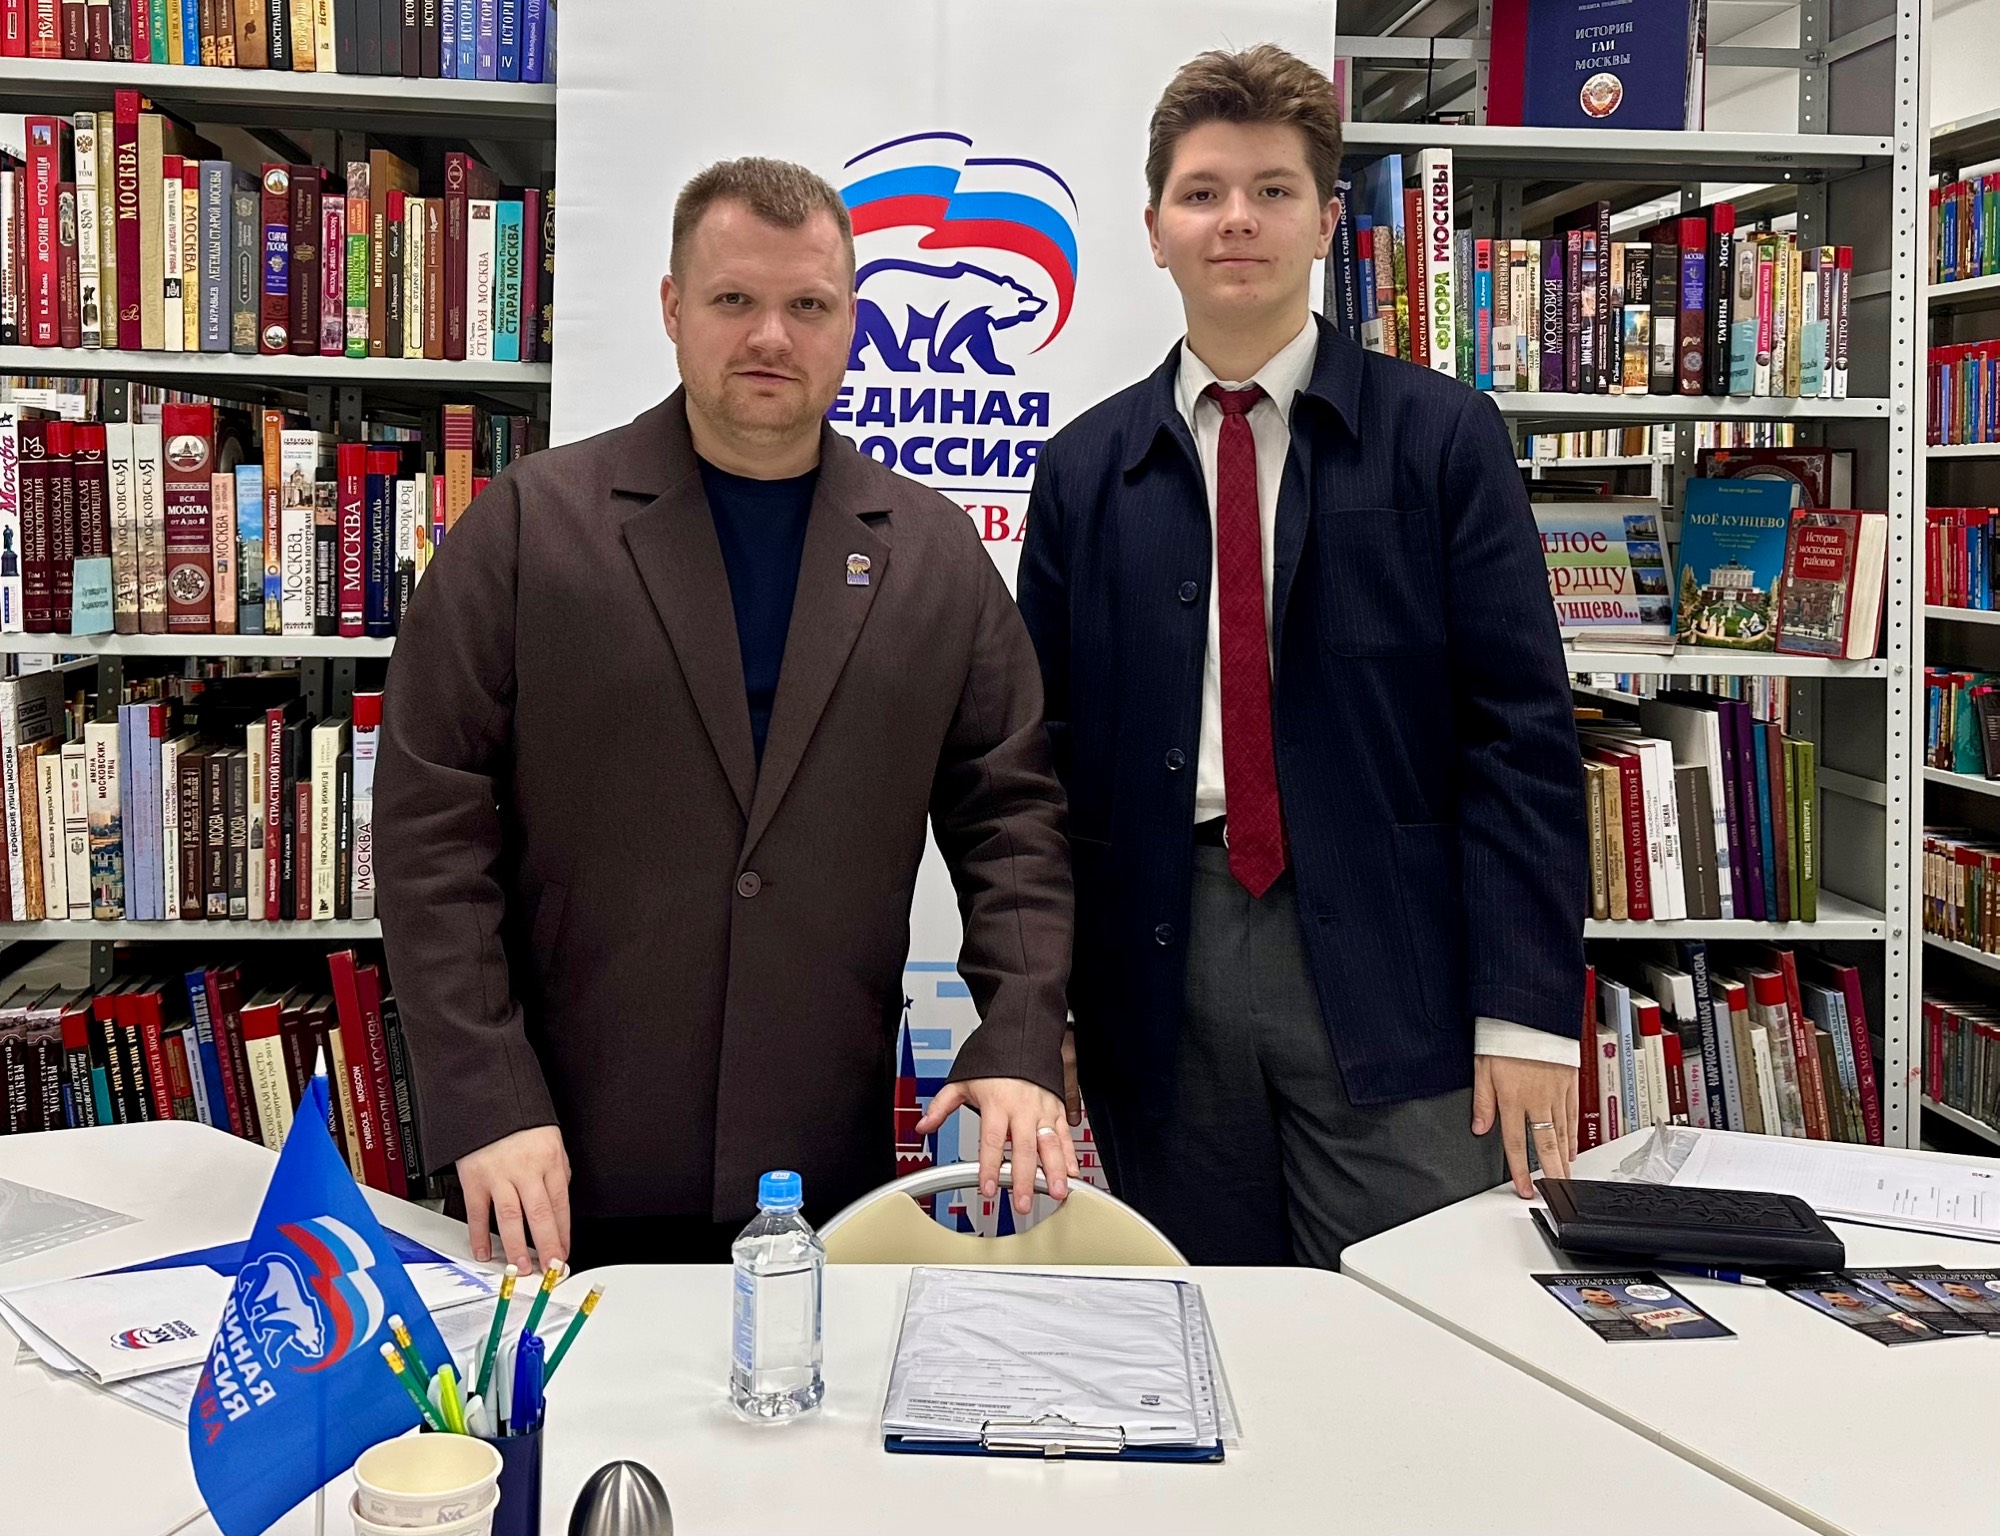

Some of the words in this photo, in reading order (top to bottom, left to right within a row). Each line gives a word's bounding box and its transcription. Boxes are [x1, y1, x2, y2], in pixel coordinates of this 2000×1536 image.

[137, 16, 145, 39] ДУША
[1575, 21, 1634, 40] ИСТОРИЯ
[1592, 40, 1615, 53] ГАИ
[1575, 53, 1631, 71] МОСКВЫ
[37, 157, 50, 205] СТОЛИЦА
[119, 141, 137, 220] МОСКВА
[209, 169, 222, 205] МОСКВЫ
[80, 209, 93, 229] 850
[101, 205, 113, 226] 850
[208, 206, 221, 239] СТАРОЙ
[303, 194, 312, 225] Москвы
[329, 215, 338, 240] Москва
[374, 213, 383, 239] МОСКВЫ
[1339, 192, 1347, 225] РОССИИ
[1415, 197, 1424, 240] МОСКВЫ
[1432, 164, 1450, 262] МОСКВЫ
[37, 217, 49, 262] МОСКВА
[184, 205, 197, 273] МОСКВА
[328, 246, 338, 269] сердце
[506, 223, 519, 279] МОСКВА
[1341, 227, 1349, 256] СУДЬБЕ
[1599, 208, 1609, 277] МИСТИЧЕСКАЯ
[209, 241, 221, 281] ЛЕГЕНДЫ
[476, 251, 489, 304] МОСКВА
[497, 259, 506, 299] Иванович
[1417, 242, 1425, 278] ГОРОДА
[329, 270, 338, 294] России
[412, 272, 420, 300] СТАРОЙ
[1343, 265, 1354, 320] МОСКВА-РЕКА
[1418, 281, 1426, 313] КНИГА
[1499, 257, 1508, 315] ТАИНСТВЕННАЯ
[1599, 280, 1608, 320] МОСКВА
[1822, 271, 1831, 317] московское
[1841, 271, 1849, 317] московское
[209, 286, 219, 324] МУРАВЬЕВ
[497, 301, 505, 334] Михаил
[506, 282, 519, 335] СТАРАЯ
[1434, 271, 1451, 351] ФЛОРА
[1543, 278, 1557, 355] МОСКОВИЯ
[1717, 298, 1728, 344] ТАЙНЫ
[475, 309, 488, 357] СТАРАЯ
[1386, 313, 1395, 347] МОСКВЫ
[1418, 314, 1426, 357] КРАСНАЯ
[1839, 319, 1848, 356] МЕТРО
[826, 387, 1049, 427] ЕДИНАЯ
[0, 434, 18, 517] Москва
[859, 436, 1047, 477] ОССИЯ
[112, 458, 128, 547] МОСКОВСКАЯ
[138, 458, 154, 547] МОСКОВСКАЯ
[167, 505, 209, 515] МОСКВА
[180, 495, 196, 503] ВСЯ
[269, 494, 277, 529] МИХАИЛОМ
[400, 485, 414, 506] Вся
[23, 477, 34, 562] МОСКОВСКАЯ
[35, 477, 46, 561] ЭНЦИКЛОПЕДИЯ
[51, 477, 62, 561] МОСКОВСКАЯ
[63, 477, 74, 561] ЭНЦИКЛОПЕДИЯ
[79, 479, 91, 557] ОСКОВСКАЯ
[304, 513, 313, 557] потеряли
[400, 508, 413, 551] Москва
[1689, 512, 1719, 525] МОЁ
[1720, 514, 1785, 530] КУНЦЕВО
[343, 500, 361, 592] МОСКВА
[372, 498, 383, 583] ПУТЕВОДИТЕЛЬ
[1799, 544, 1843, 557] московских
[1805, 531, 1839, 545] История
[117, 552, 133, 601] АЗБУКА
[143, 552, 158, 601] АЗБУКА
[283, 528, 304, 603] Москва,
[304, 559, 313, 575] мы
[316, 541, 329, 582] погибшая
[1802, 555, 1836, 568] районов
[304, 576, 313, 617] которую
[316, 584, 329, 617] Москва
[271, 719, 282, 764] БУЛЬВАР
[5, 746, 14, 781] МОСКВЫ
[44, 765, 53, 795] Москвы
[89, 757, 97, 784] ИМЕНА
[97, 741, 107, 799] МОСКОВСКИХ
[107, 759, 116, 780] УЛИЦ
[7, 782, 16, 811] УЛИЦЫ
[212, 788, 221, 806] улицах
[268, 765, 281, 826] СТРАСТНОЙ
[320, 771, 328, 805] ВЕЛИКИЙ
[1629, 777, 1638, 807] ТВОЯ
[47, 796, 57, 825] радиусы
[192, 808, 200, 835] улицах
[208, 813, 225, 846] МОСКВА
[300, 792, 308, 834] ПРЕЧИСТЕНКА
[320, 806, 328, 831] ПОСАД
[1646, 789, 1654, 839] ТРАНСФОРМАЦИЯ
[1662, 804, 1671, 828] МОСКВА
[48, 832, 56, 858] Кольца
[230, 815, 247, 847] МОСКВА
[1631, 821, 1641, 847] МОЯ
[1665, 834, 1673, 858] MOSCOW
[283, 859, 291, 880] Юрий
[357, 821, 372, 891] МОСКВА
[1651, 842, 1659, 863] МОСКВА
[1633, 849, 1645, 898] МОСКВА
[191, 985, 205, 993] 2
[1693, 952, 1709, 998] МОСКВА
[192, 993, 213, 1044] ЛУБЯНКА
[1829, 1003, 1843, 1056] ХУДОЖНИКОВ
[1839, 1003, 1853, 1057] ХУДОЖНИКОВ
[230, 1032, 242, 1060] ЛЮДЕЙ
[265, 1042, 277, 1077] 1708-2012
[366, 1011, 386, 1072] МОСКВЫ
[389, 1026, 403, 1076] ГОСУДАРСТВА
[1624, 1033, 1632, 1057] ОКНА
[1698, 1000, 1720, 1086] НАРИСОВАННАЯ
[1853, 1015, 1870, 1069] MOSCOW
[4, 1046, 14, 1081] СТАРОЙ
[38, 1046, 48, 1083] СТАРОЙ
[68, 1054, 81, 1090] ИСТОРИИ
[77, 1053, 87, 1074] УЛИЦ
[107, 1046, 124, 1091] МОСКВЫ
[128, 1046, 145, 1091] МОСКВЫ
[151, 1053, 165, 1088] ВЛАСТИ
[256, 1051, 269, 1089] ВЛАСТЬ
[14, 1064, 27, 1112] МОСКВЫ
[48, 1065, 60, 1113] МОСКВЫ
[75, 1091, 83, 1103] ИЗ
[236, 1073, 247, 1098] ГОРОД
[352, 1065, 366, 1103] MOSCOW
[1625, 1059, 1636, 1120] МОСКОВСКОГО
[7, 1084, 17, 1132] ПЕРЕУЛКИ
[241, 1105, 255, 1136] МОСКВА
[376, 1076, 398, 1161] СИМВОЛИКА
[360, 1111, 374, 1150] SYMBOLS
[403, 1126, 417, 1168] СОЗДАТЕЛИ
[1588, 1122, 1597, 1140] 1917
[226, 1296, 277, 1407] ДИНАЯ
